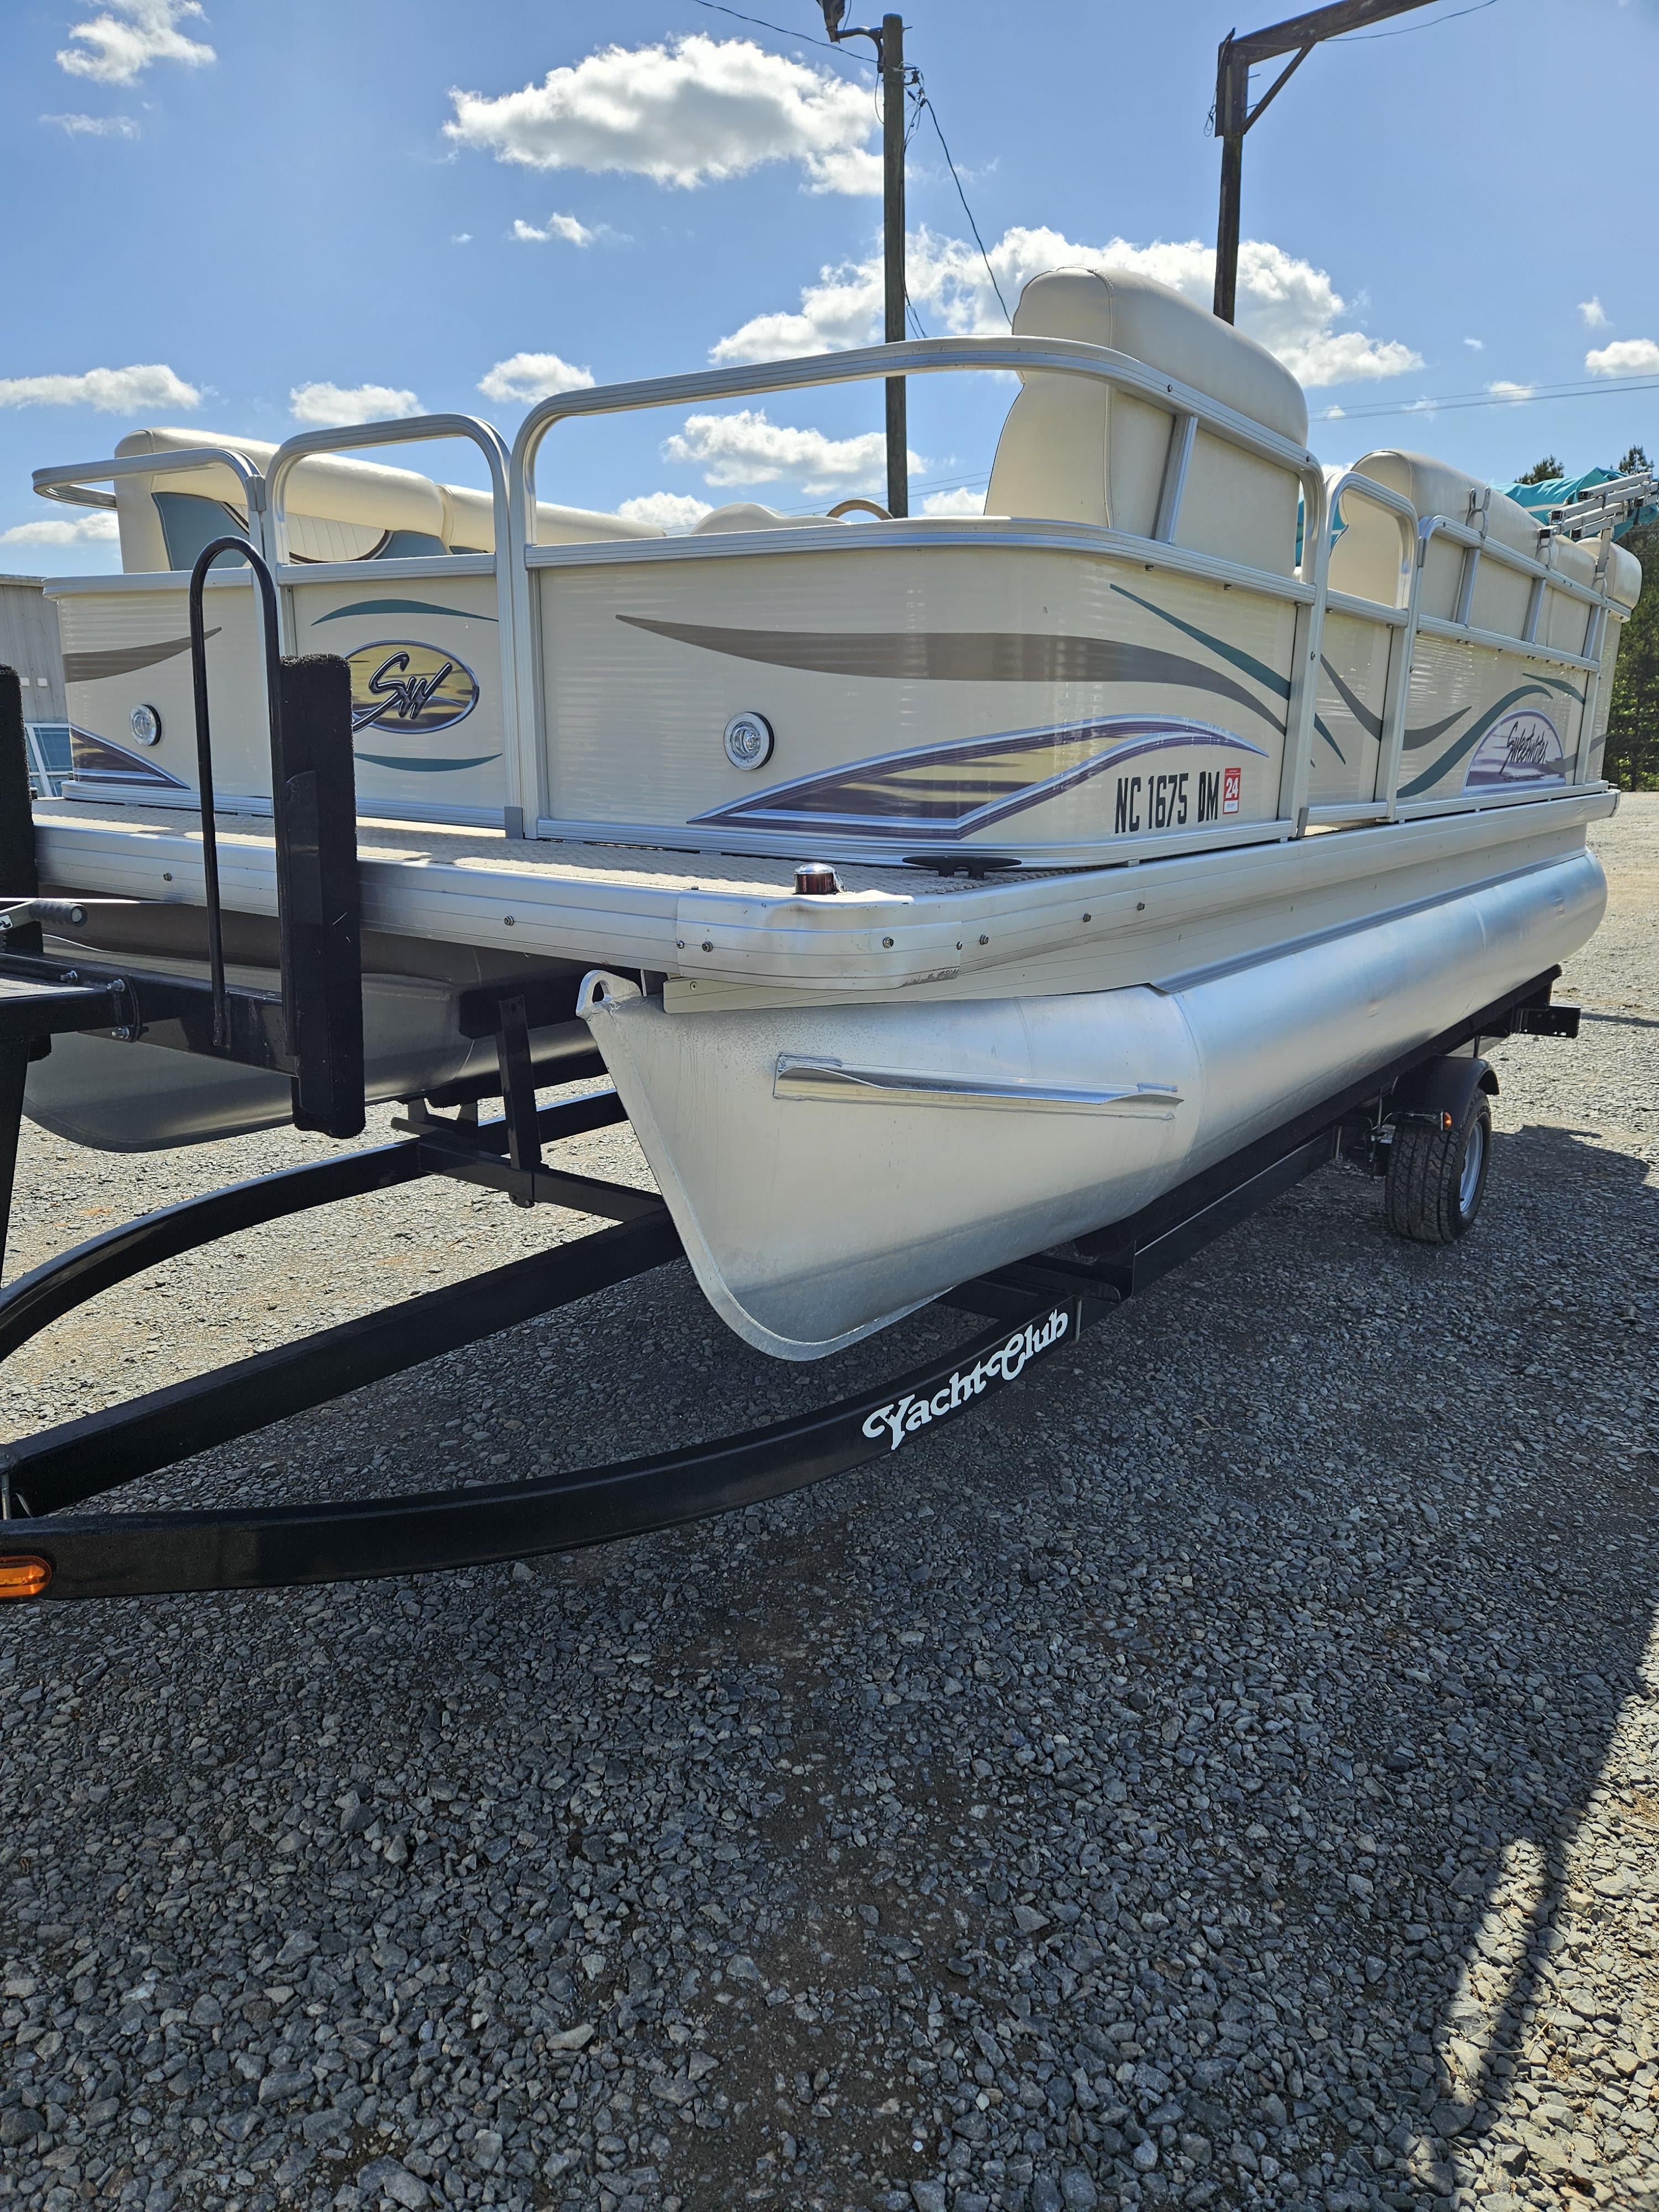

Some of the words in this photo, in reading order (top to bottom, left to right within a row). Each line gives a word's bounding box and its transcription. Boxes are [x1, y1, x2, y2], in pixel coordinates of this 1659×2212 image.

[352, 651, 452, 733] SW
[1115, 777, 1141, 833] NC
[1148, 773, 1188, 829] 1675
[1198, 771, 1220, 823] DM
[1225, 777, 1238, 799] 24
[862, 1361, 987, 1450] Yacht
[985, 1308, 1068, 1380] Club
